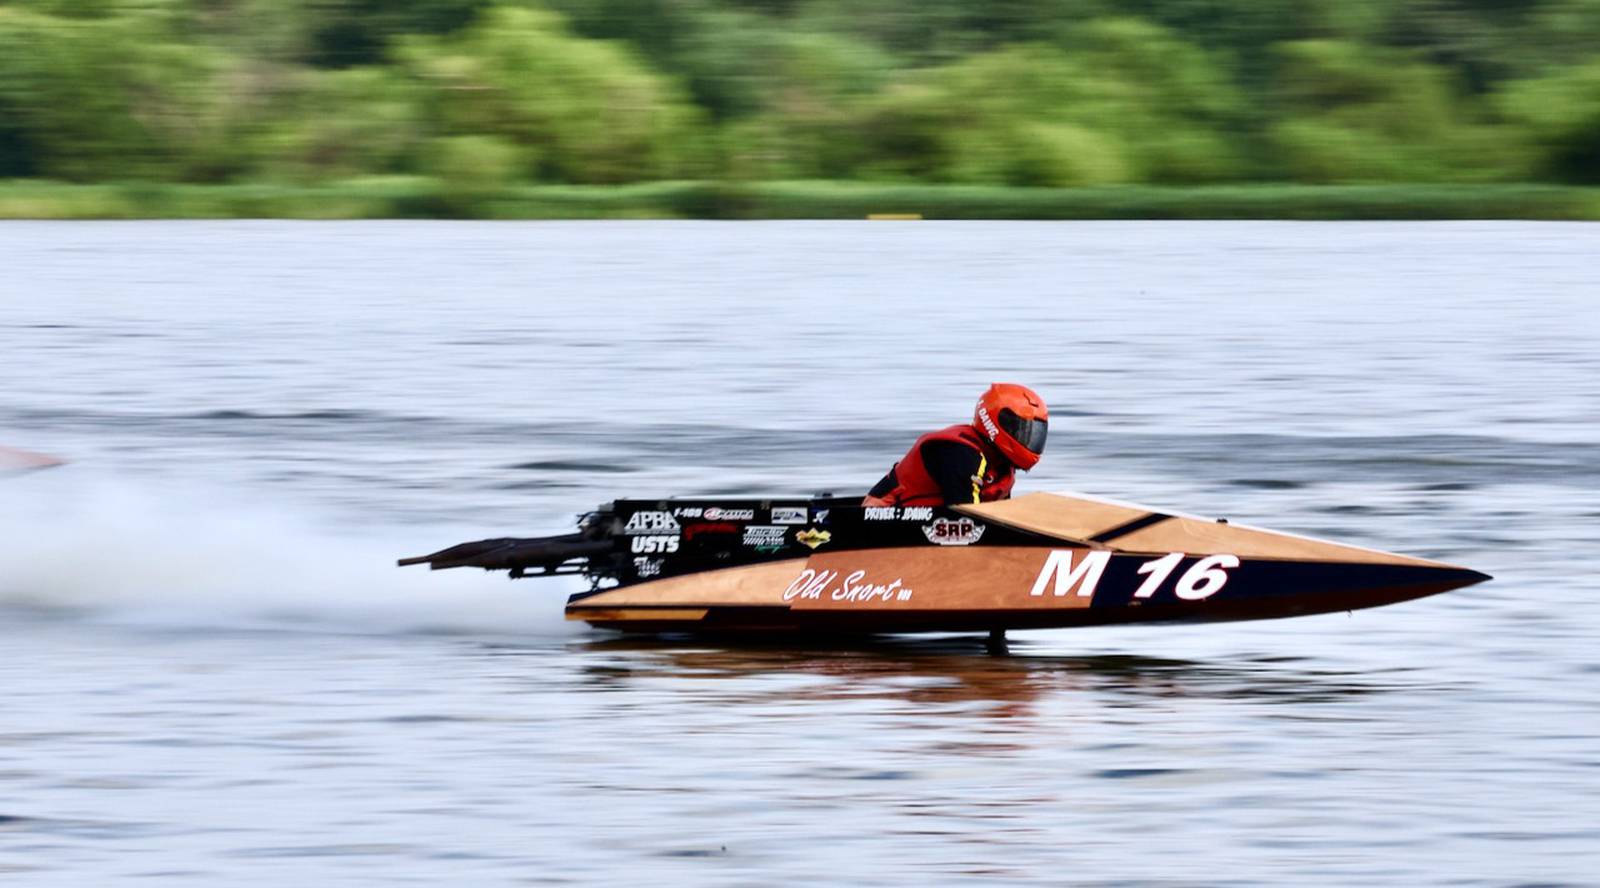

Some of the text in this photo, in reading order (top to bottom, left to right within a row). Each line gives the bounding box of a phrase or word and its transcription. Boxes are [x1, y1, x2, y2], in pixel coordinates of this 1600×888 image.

[624, 511, 680, 530] APBA
[935, 523, 972, 538] SRP
[631, 535, 680, 553] USTS
[783, 568, 838, 600] Old
[1030, 550, 1240, 600] M 16
